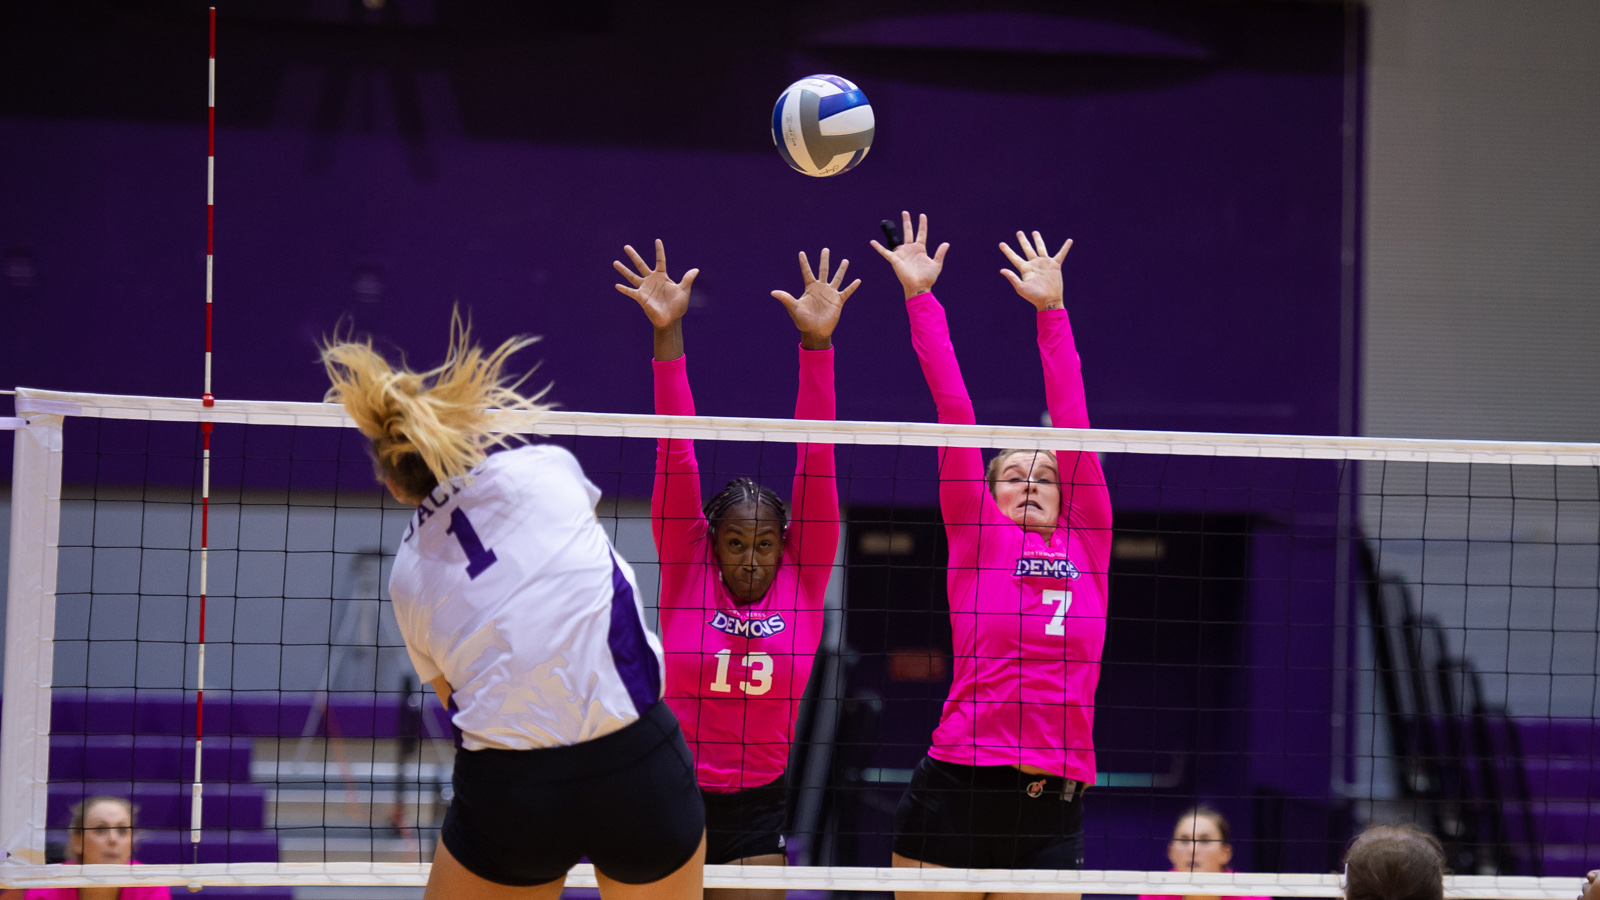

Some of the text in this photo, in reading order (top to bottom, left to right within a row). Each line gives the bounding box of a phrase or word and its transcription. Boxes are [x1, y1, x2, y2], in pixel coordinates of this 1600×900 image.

[446, 507, 497, 580] 1
[710, 611, 786, 638] DEMONS
[1042, 589, 1072, 636] 7
[710, 649, 773, 695] 13
